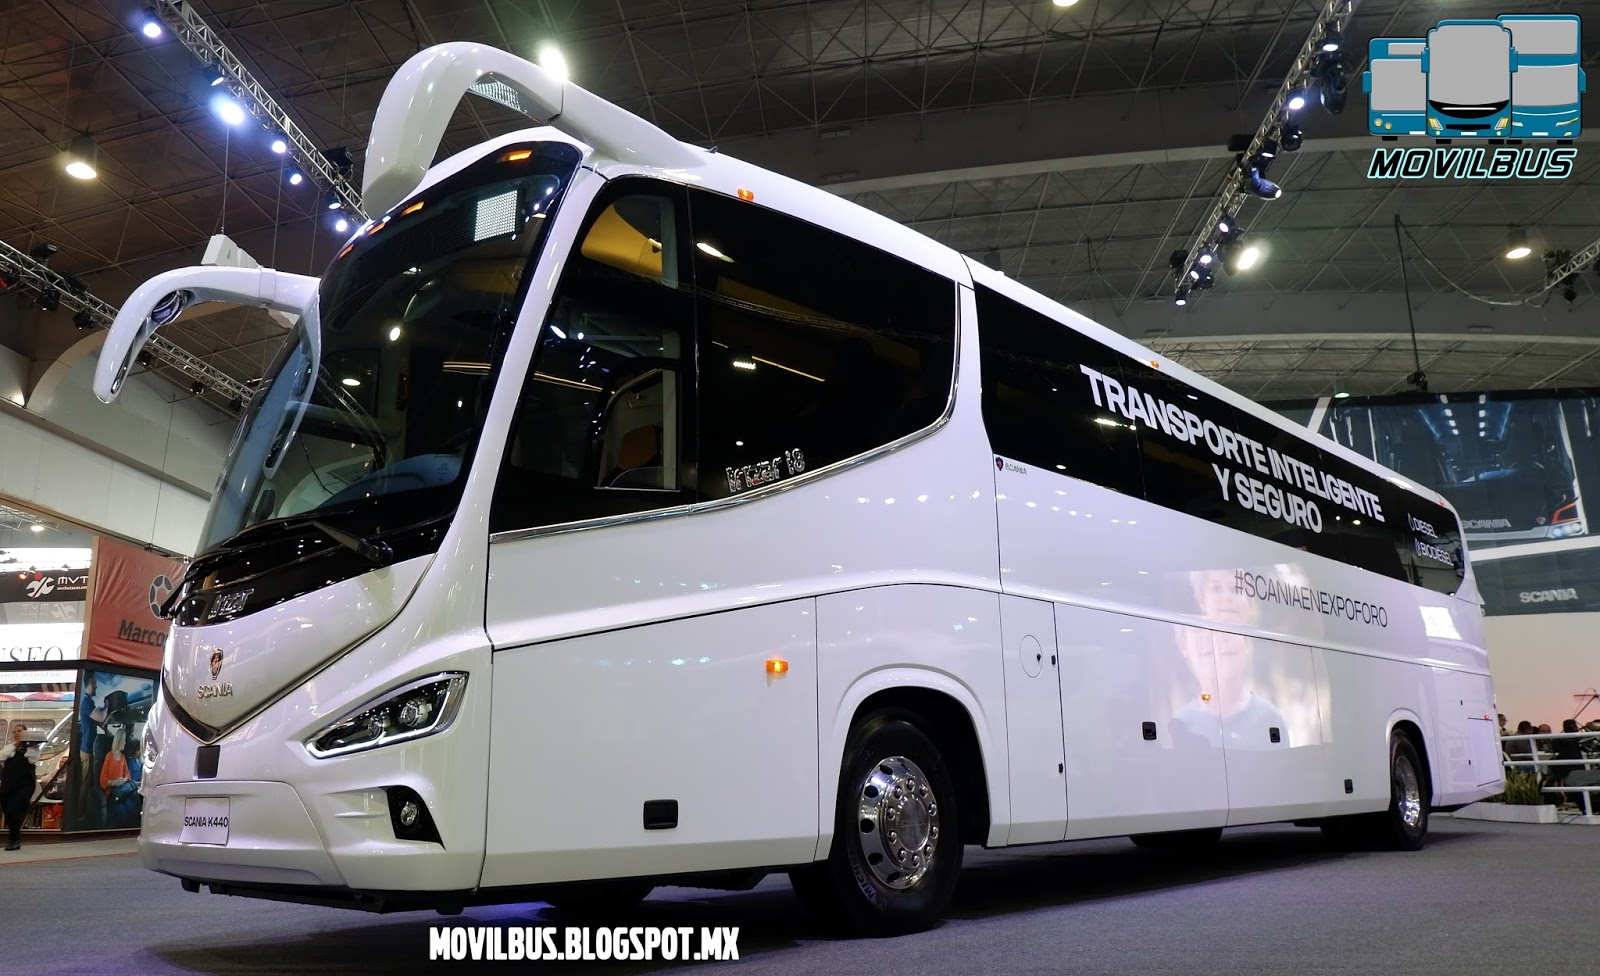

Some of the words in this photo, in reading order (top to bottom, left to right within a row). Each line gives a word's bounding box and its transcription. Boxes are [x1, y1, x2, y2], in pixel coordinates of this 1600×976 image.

[1079, 364, 1270, 474] TRANSPORTE
[1266, 446, 1385, 523] INTELIGENTE
[1211, 463, 1231, 502] Y
[1234, 472, 1323, 534] SEGURO
[1461, 518, 1512, 529] SCANIA
[1234, 569, 1388, 628] #SCANIAENEXPOFORO
[1519, 588, 1579, 603] SCANIA
[118, 619, 167, 647] Marco
[197, 682, 233, 699] SCANIA
[184, 816, 207, 827] SCANIA
[208, 816, 229, 827] K440
